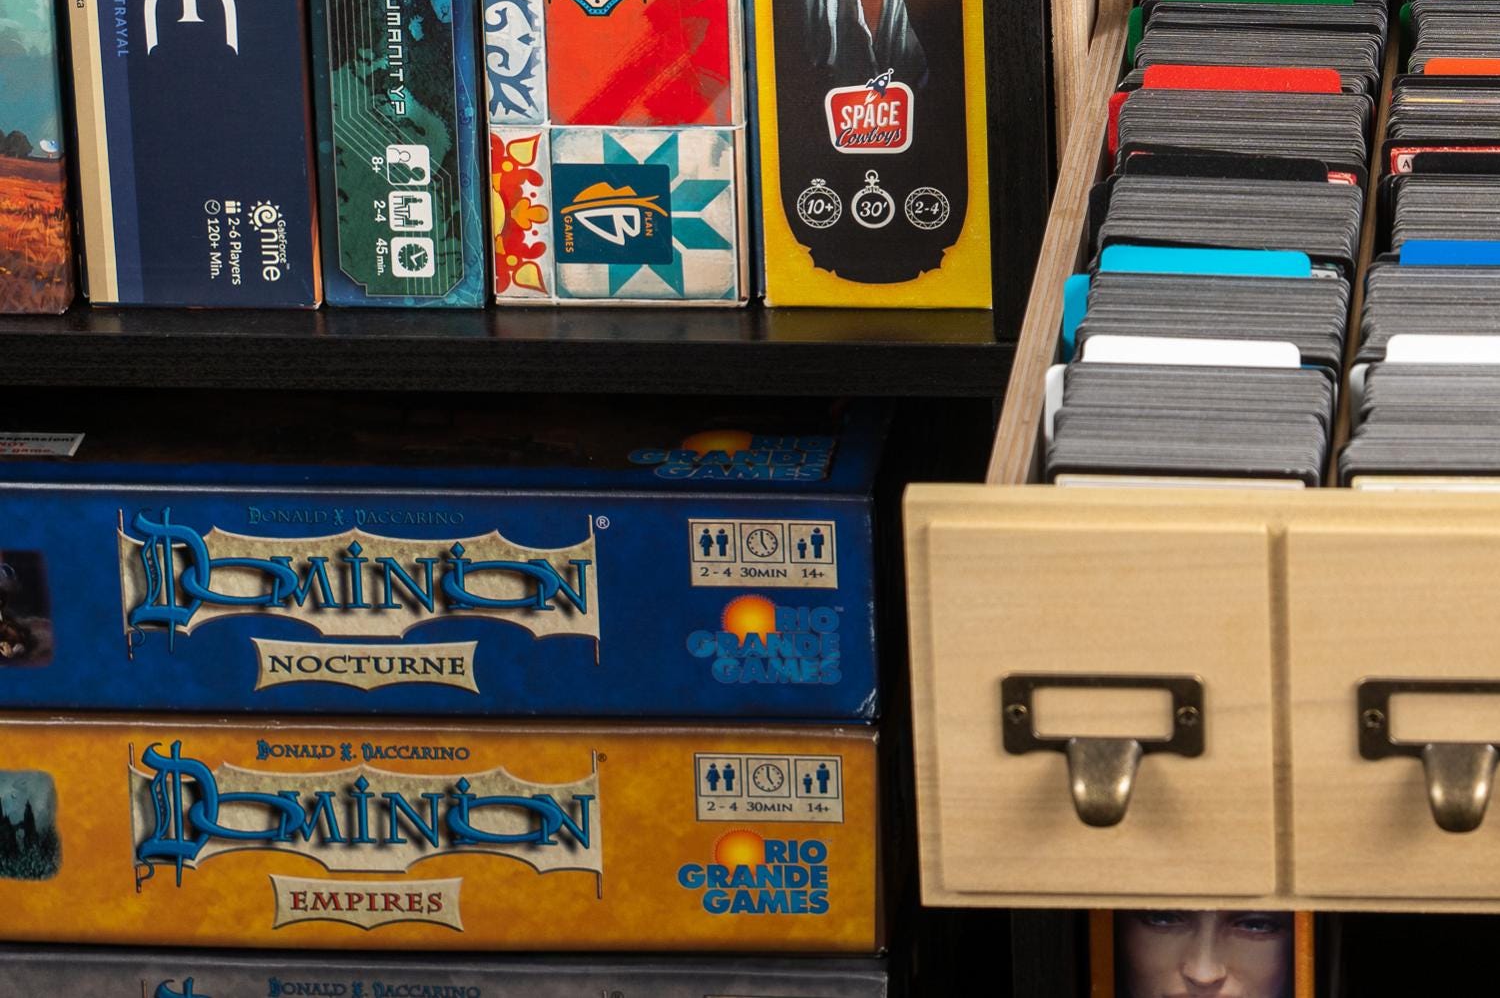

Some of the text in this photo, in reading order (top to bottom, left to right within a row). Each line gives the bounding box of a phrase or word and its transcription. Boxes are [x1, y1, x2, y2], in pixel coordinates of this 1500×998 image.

[839, 99, 901, 130] SPACE
[835, 126, 902, 148] Cowboys
[371, 155, 384, 173] 8+
[373, 200, 386, 223] 2-4
[806, 198, 834, 215] 10+
[859, 201, 888, 217] 30'
[914, 201, 940, 215] 2-4
[563, 214, 574, 253] GAMES
[574, 206, 641, 246] B
[644, 211, 654, 237] PLAN
[207, 217, 222, 280] 120+ Min.
[228, 217, 242, 286] 2-6 Players
[260, 228, 281, 282] nine
[375, 237, 388, 277] 45 min.
[627, 448, 833, 466] GRANDE
[653, 464, 831, 481] GAMES
[130, 506, 593, 654] DOMINION
[700, 567, 711, 579] 2
[722, 567, 733, 579] 4
[740, 566, 788, 579] 30MIN
[801, 569, 826, 580] 14+
[775, 606, 840, 634] RIO
[686, 630, 841, 660] GRANDE
[268, 654, 466, 676] NOCTURNE
[711, 658, 842, 685] GAMES
[256, 739, 335, 760] DONALD
[361, 742, 471, 762] VACCARINO
[137, 739, 596, 888] DOMINION
[706, 802, 717, 813] 2
[727, 802, 739, 813] 4
[746, 802, 794, 814] 30MIN
[807, 803, 830, 813] 14+
[764, 839, 828, 865] RIO
[677, 863, 829, 890] GRANDE
[289, 891, 444, 915] EMPIRES
[702, 888, 830, 916] GAMES
